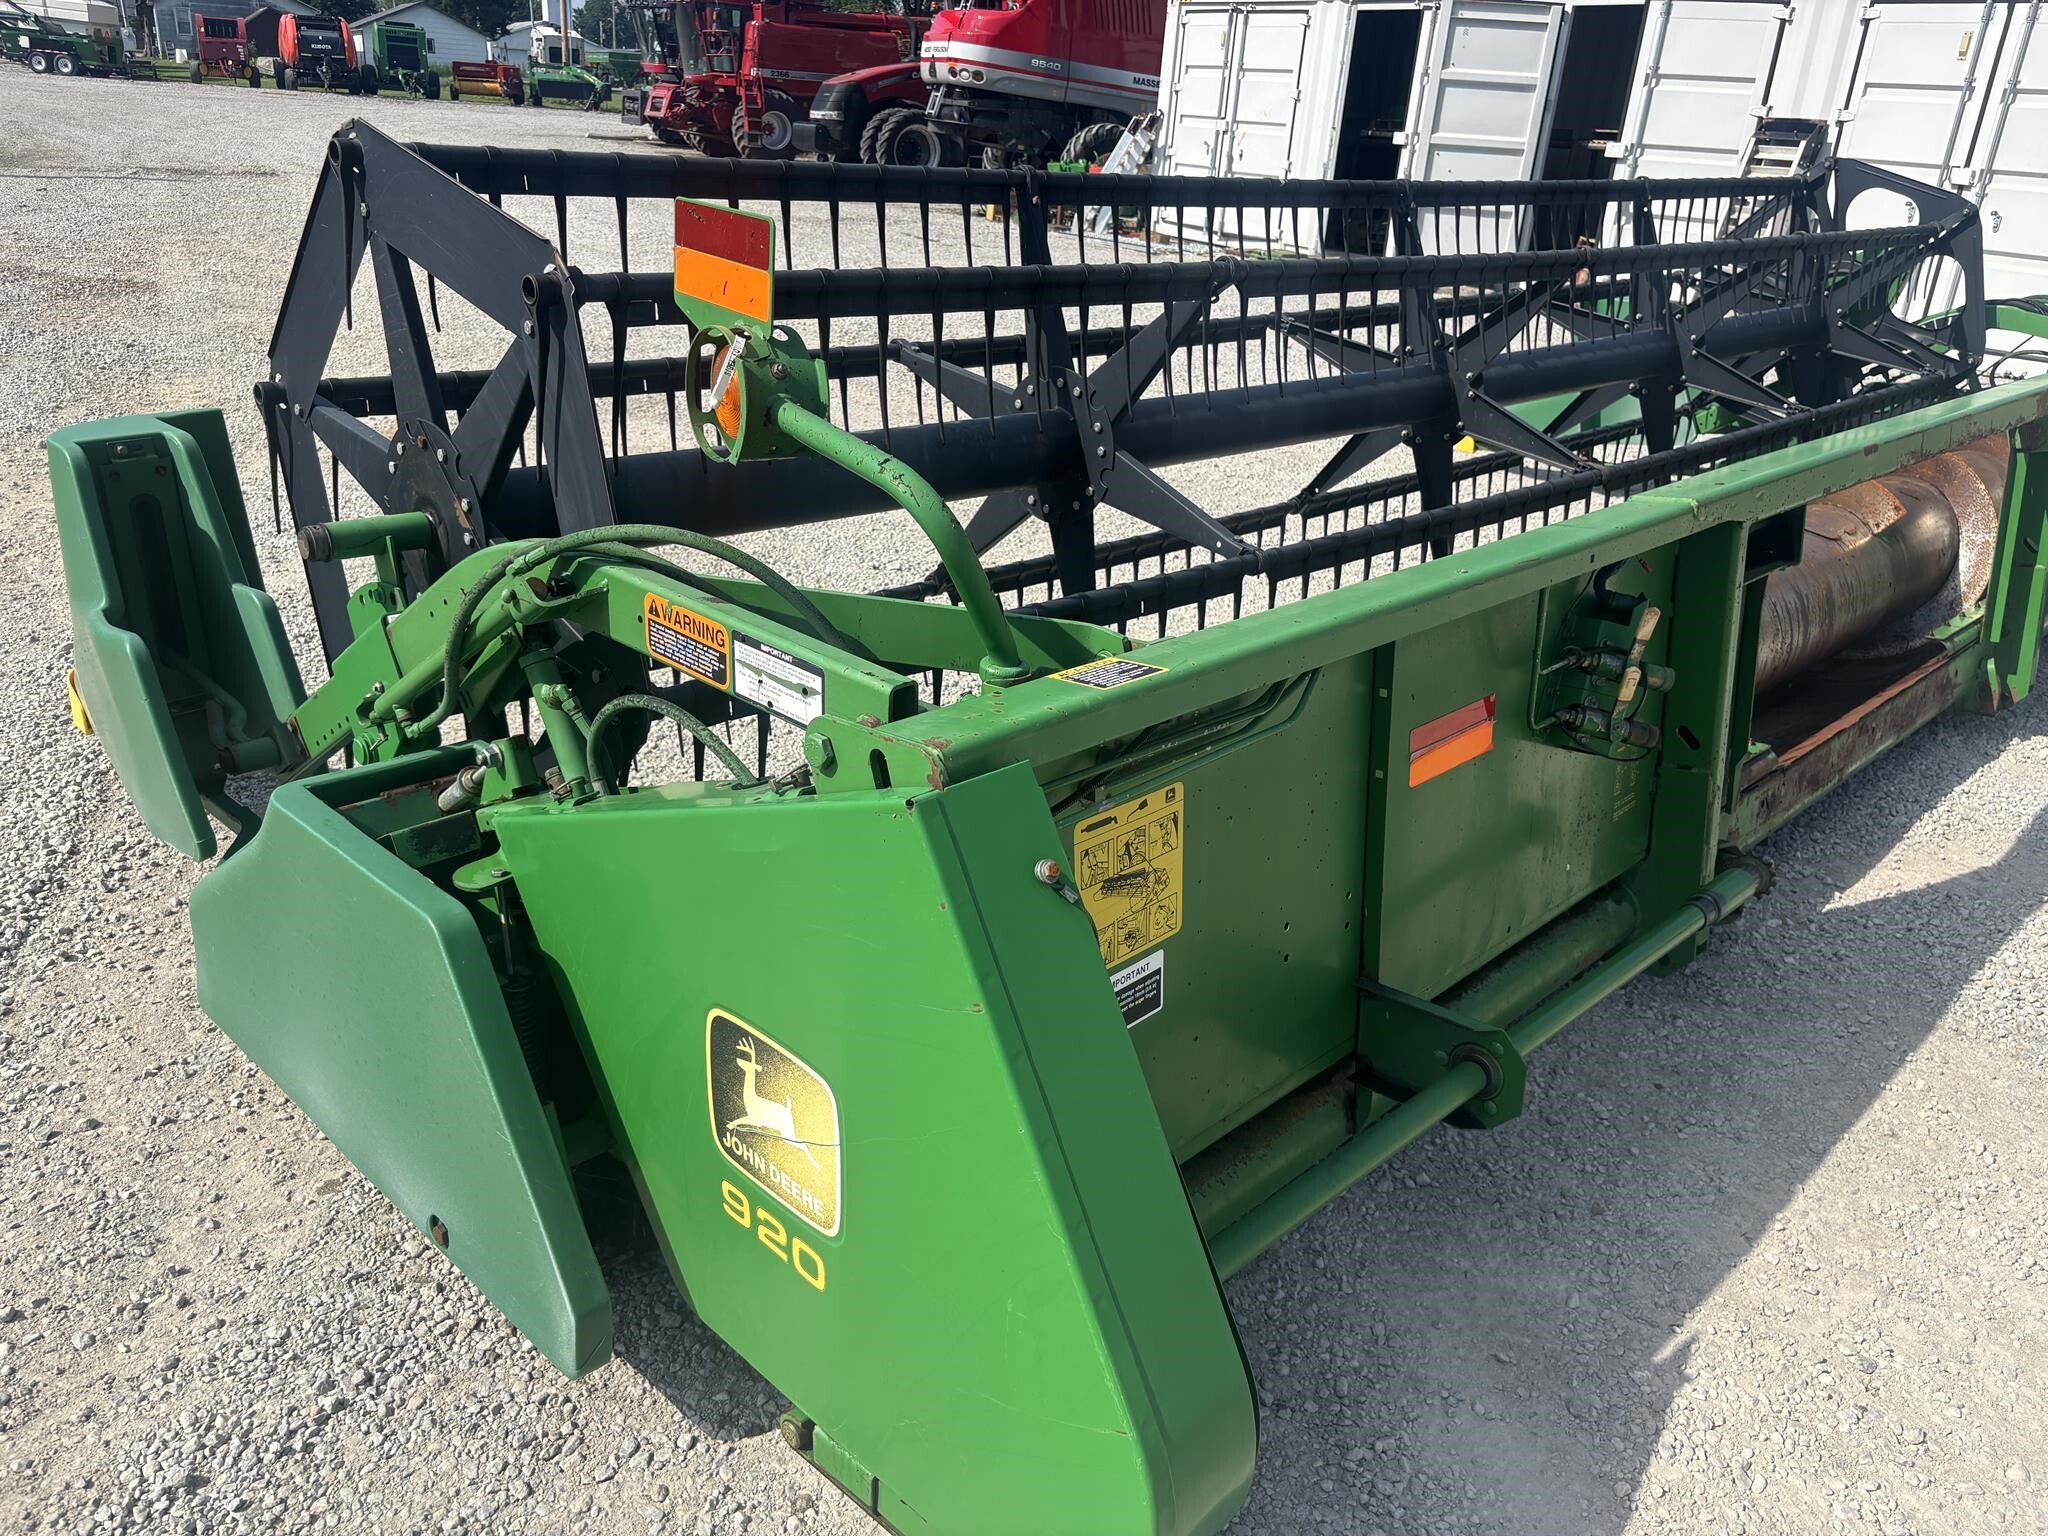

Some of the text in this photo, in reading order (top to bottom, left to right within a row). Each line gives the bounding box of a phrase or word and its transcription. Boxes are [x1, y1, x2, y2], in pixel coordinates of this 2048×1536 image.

[770, 70, 790, 79] 2366
[1031, 58, 1061, 71] 9540
[660, 603, 725, 649] WARNING
[760, 643, 793, 664] IMPORTANT
[722, 1131, 826, 1220] JOHN DEERE
[721, 1178, 826, 1292] 920
